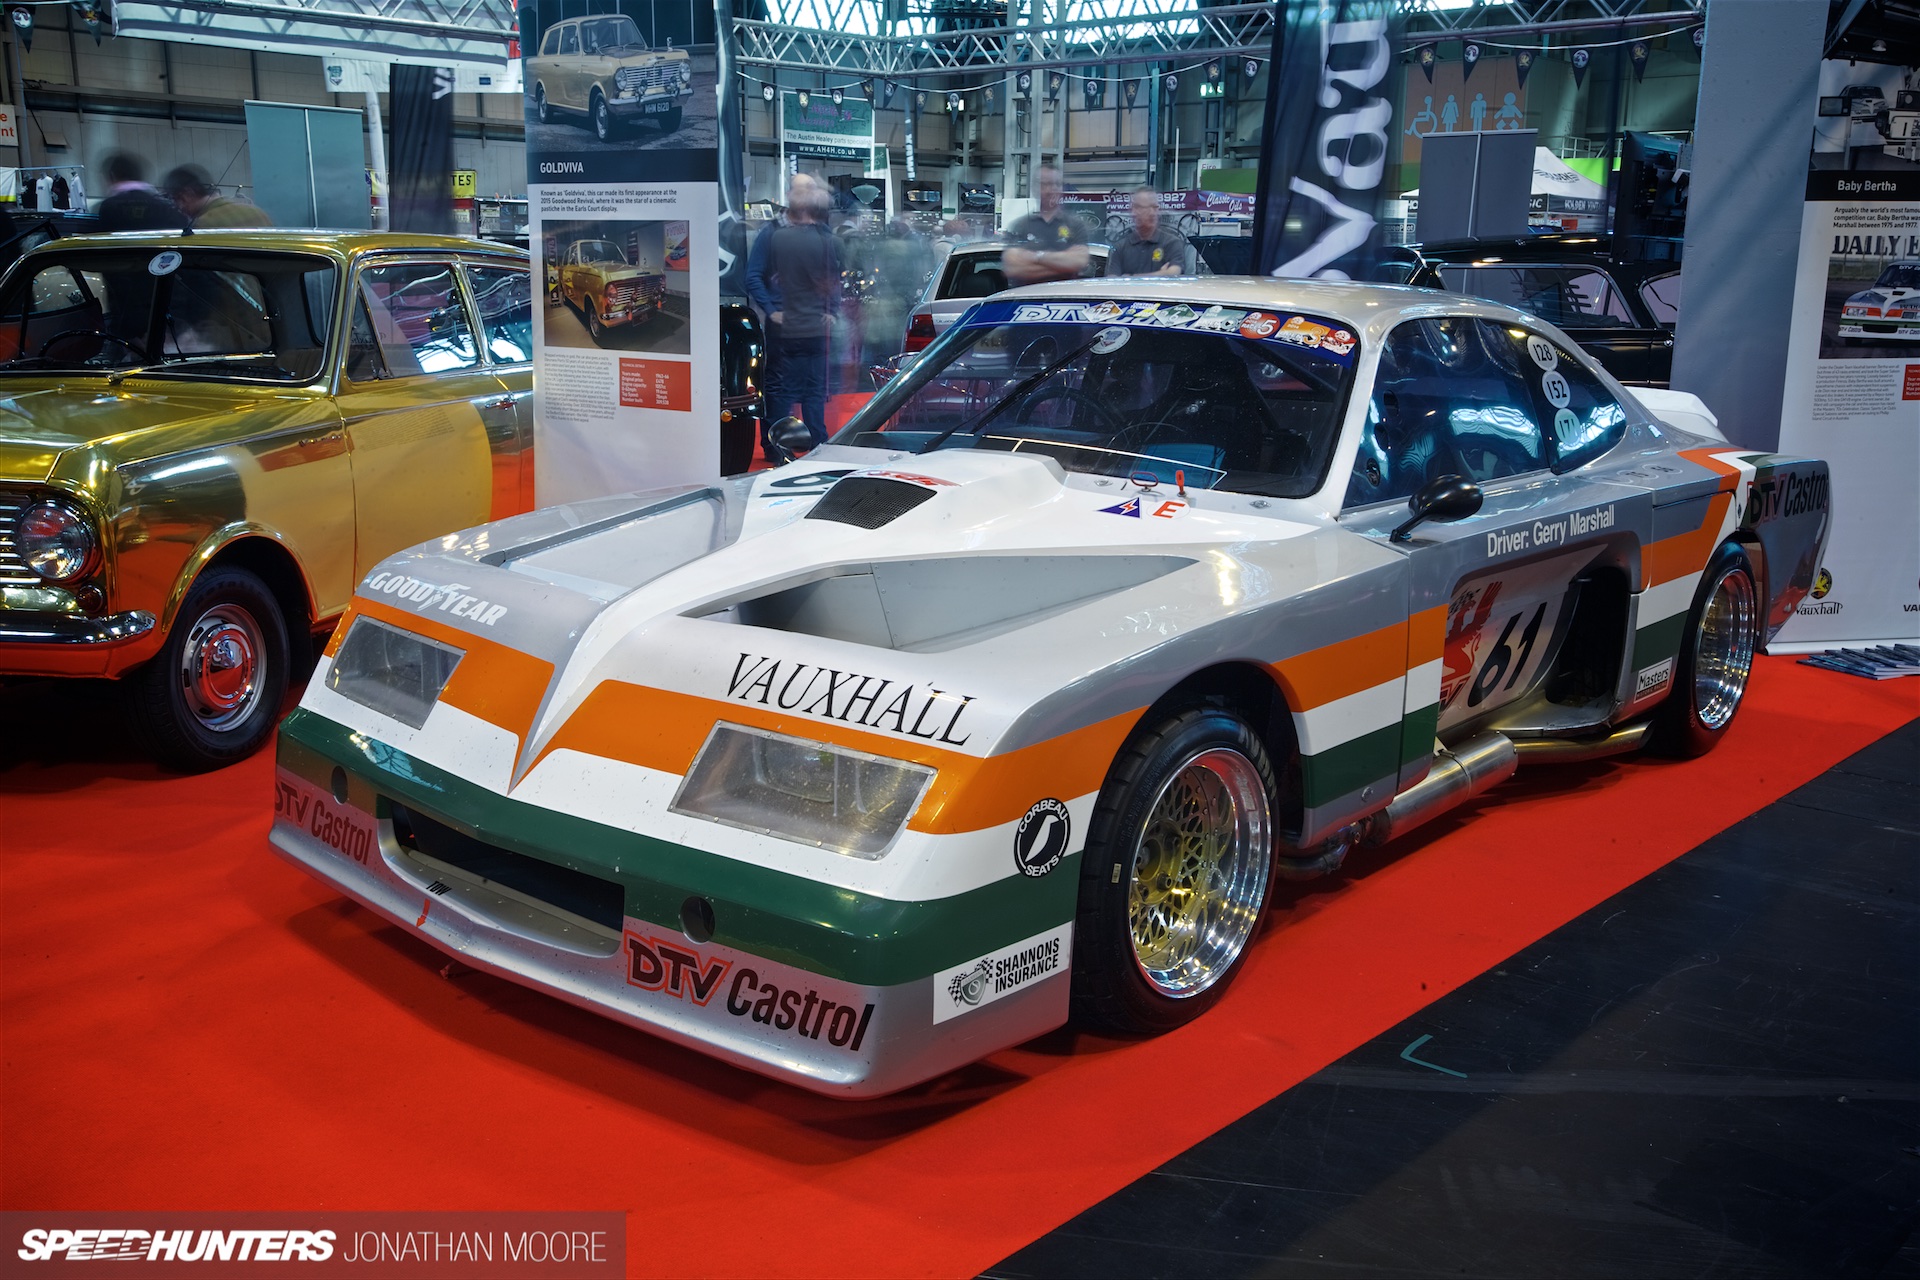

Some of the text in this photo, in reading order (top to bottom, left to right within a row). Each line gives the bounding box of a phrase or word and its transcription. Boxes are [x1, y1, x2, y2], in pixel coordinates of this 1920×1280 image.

[816, 134, 833, 143] Healey
[799, 146, 856, 155] www.AH4H.co.uk
[540, 162, 584, 174] GOLDVIVA
[1838, 180, 1897, 193] Baby Bertha
[1206, 193, 1231, 208] Classic
[1229, 200, 1243, 211] Oils
[1832, 236, 1901, 256] DAILY
[1169, 310, 1178, 322] 6
[1257, 320, 1278, 335] 5
[1533, 344, 1553, 362] 128
[1546, 380, 1567, 400] 152
[1152, 501, 1187, 518] E
[1748, 473, 1786, 526] DTV
[1487, 504, 1615, 558] Driver: Gerry Marshall
[1468, 602, 1548, 708] 61
[1639, 668, 1669, 690] Masters
[728, 652, 977, 746] VAUXHALL
[1018, 799, 1068, 834] CORBEAU
[311, 799, 372, 865] Castrol
[1025, 854, 1061, 877] SEATS
[426, 880, 452, 896] TOW
[995, 937, 1061, 978] SHANNONS
[995, 954, 1059, 994] INSURANCE
[626, 931, 876, 1052] DTV Castrol
